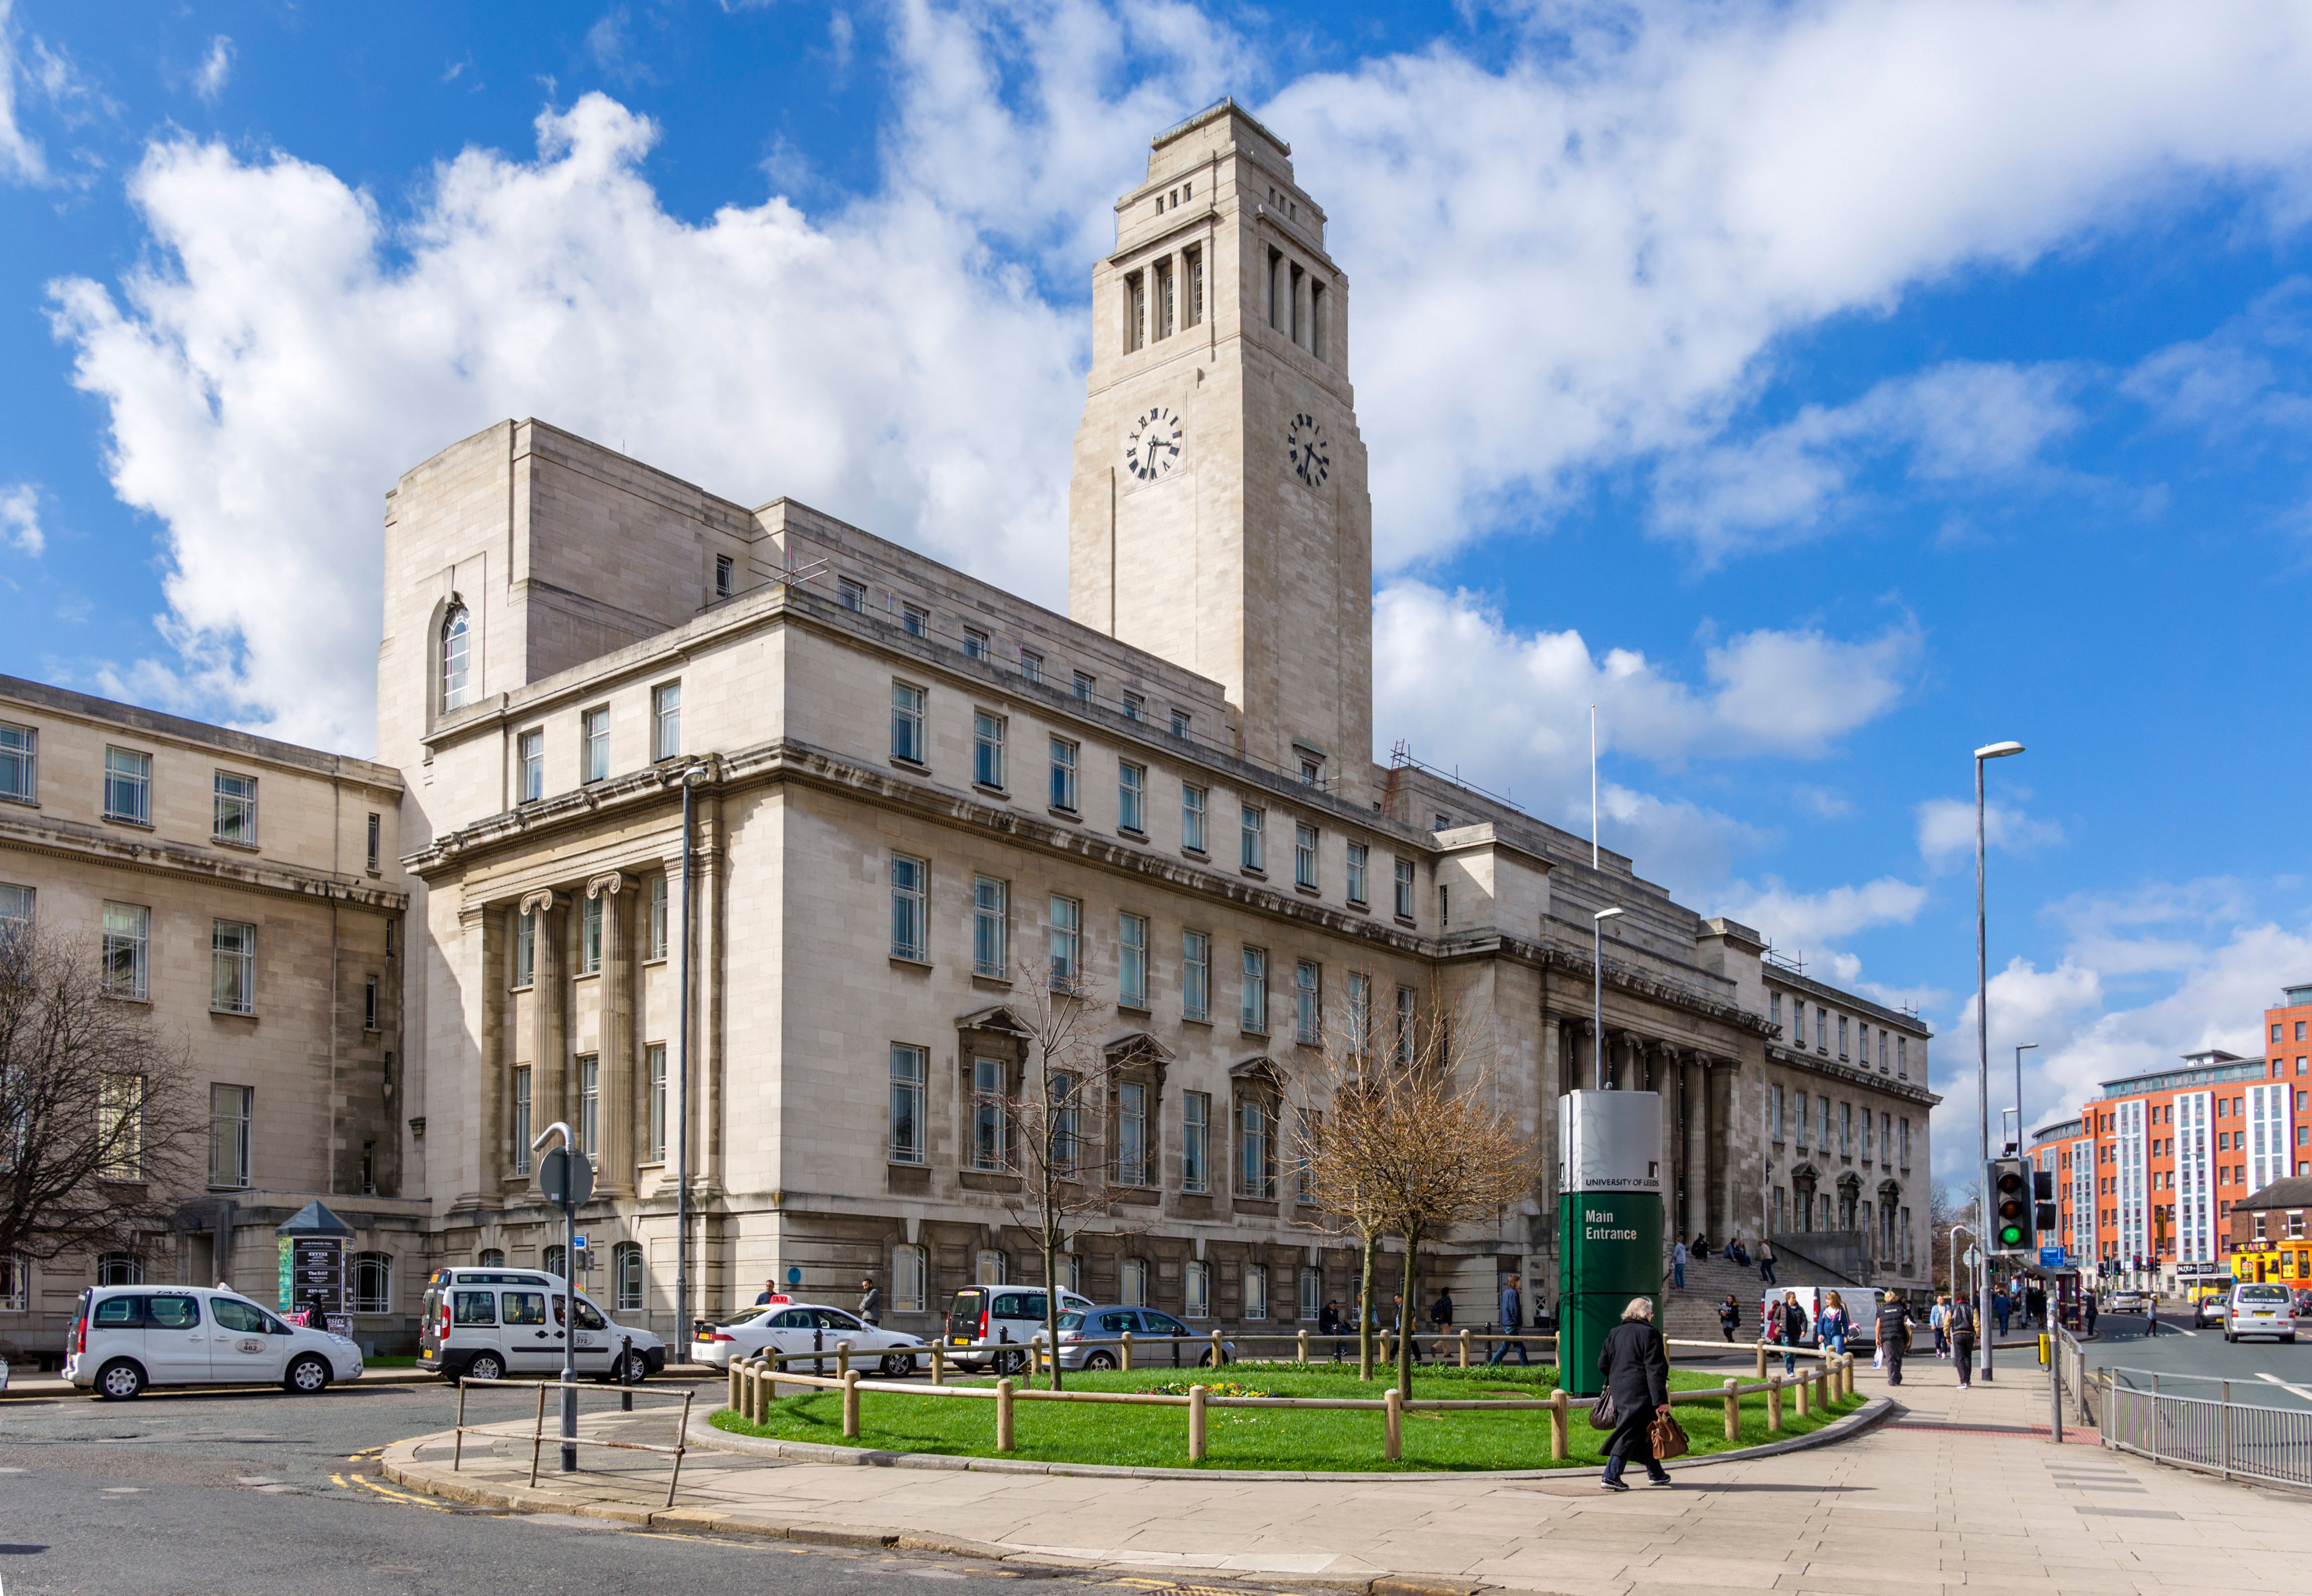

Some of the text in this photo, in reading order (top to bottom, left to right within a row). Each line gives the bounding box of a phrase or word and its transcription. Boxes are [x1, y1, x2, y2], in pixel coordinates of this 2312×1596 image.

[1586, 1210, 1613, 1223] Main
[1586, 1227, 1637, 1240] Entrance
[327, 1316, 344, 1324] asics
